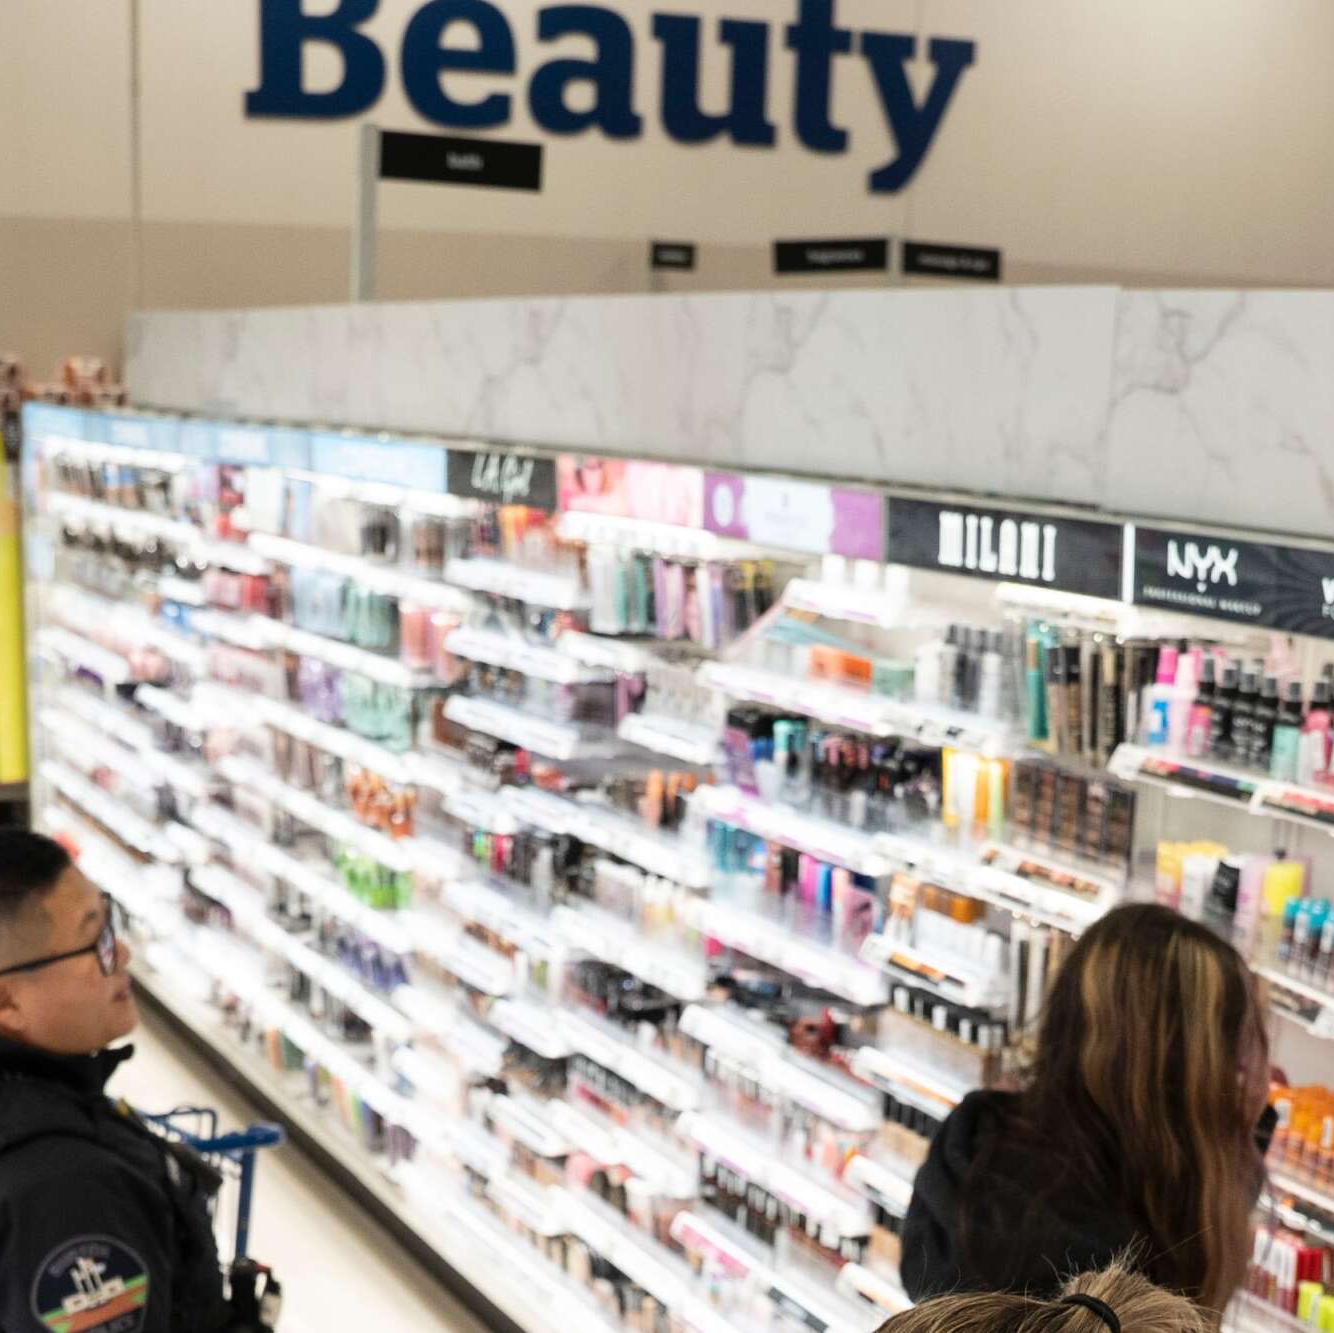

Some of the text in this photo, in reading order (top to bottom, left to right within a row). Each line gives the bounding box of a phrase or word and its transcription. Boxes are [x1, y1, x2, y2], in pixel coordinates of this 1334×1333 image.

[244, 0, 976, 194] Beauty
[938, 511, 1057, 582] MILANI
[1167, 539, 1239, 593] NYX
